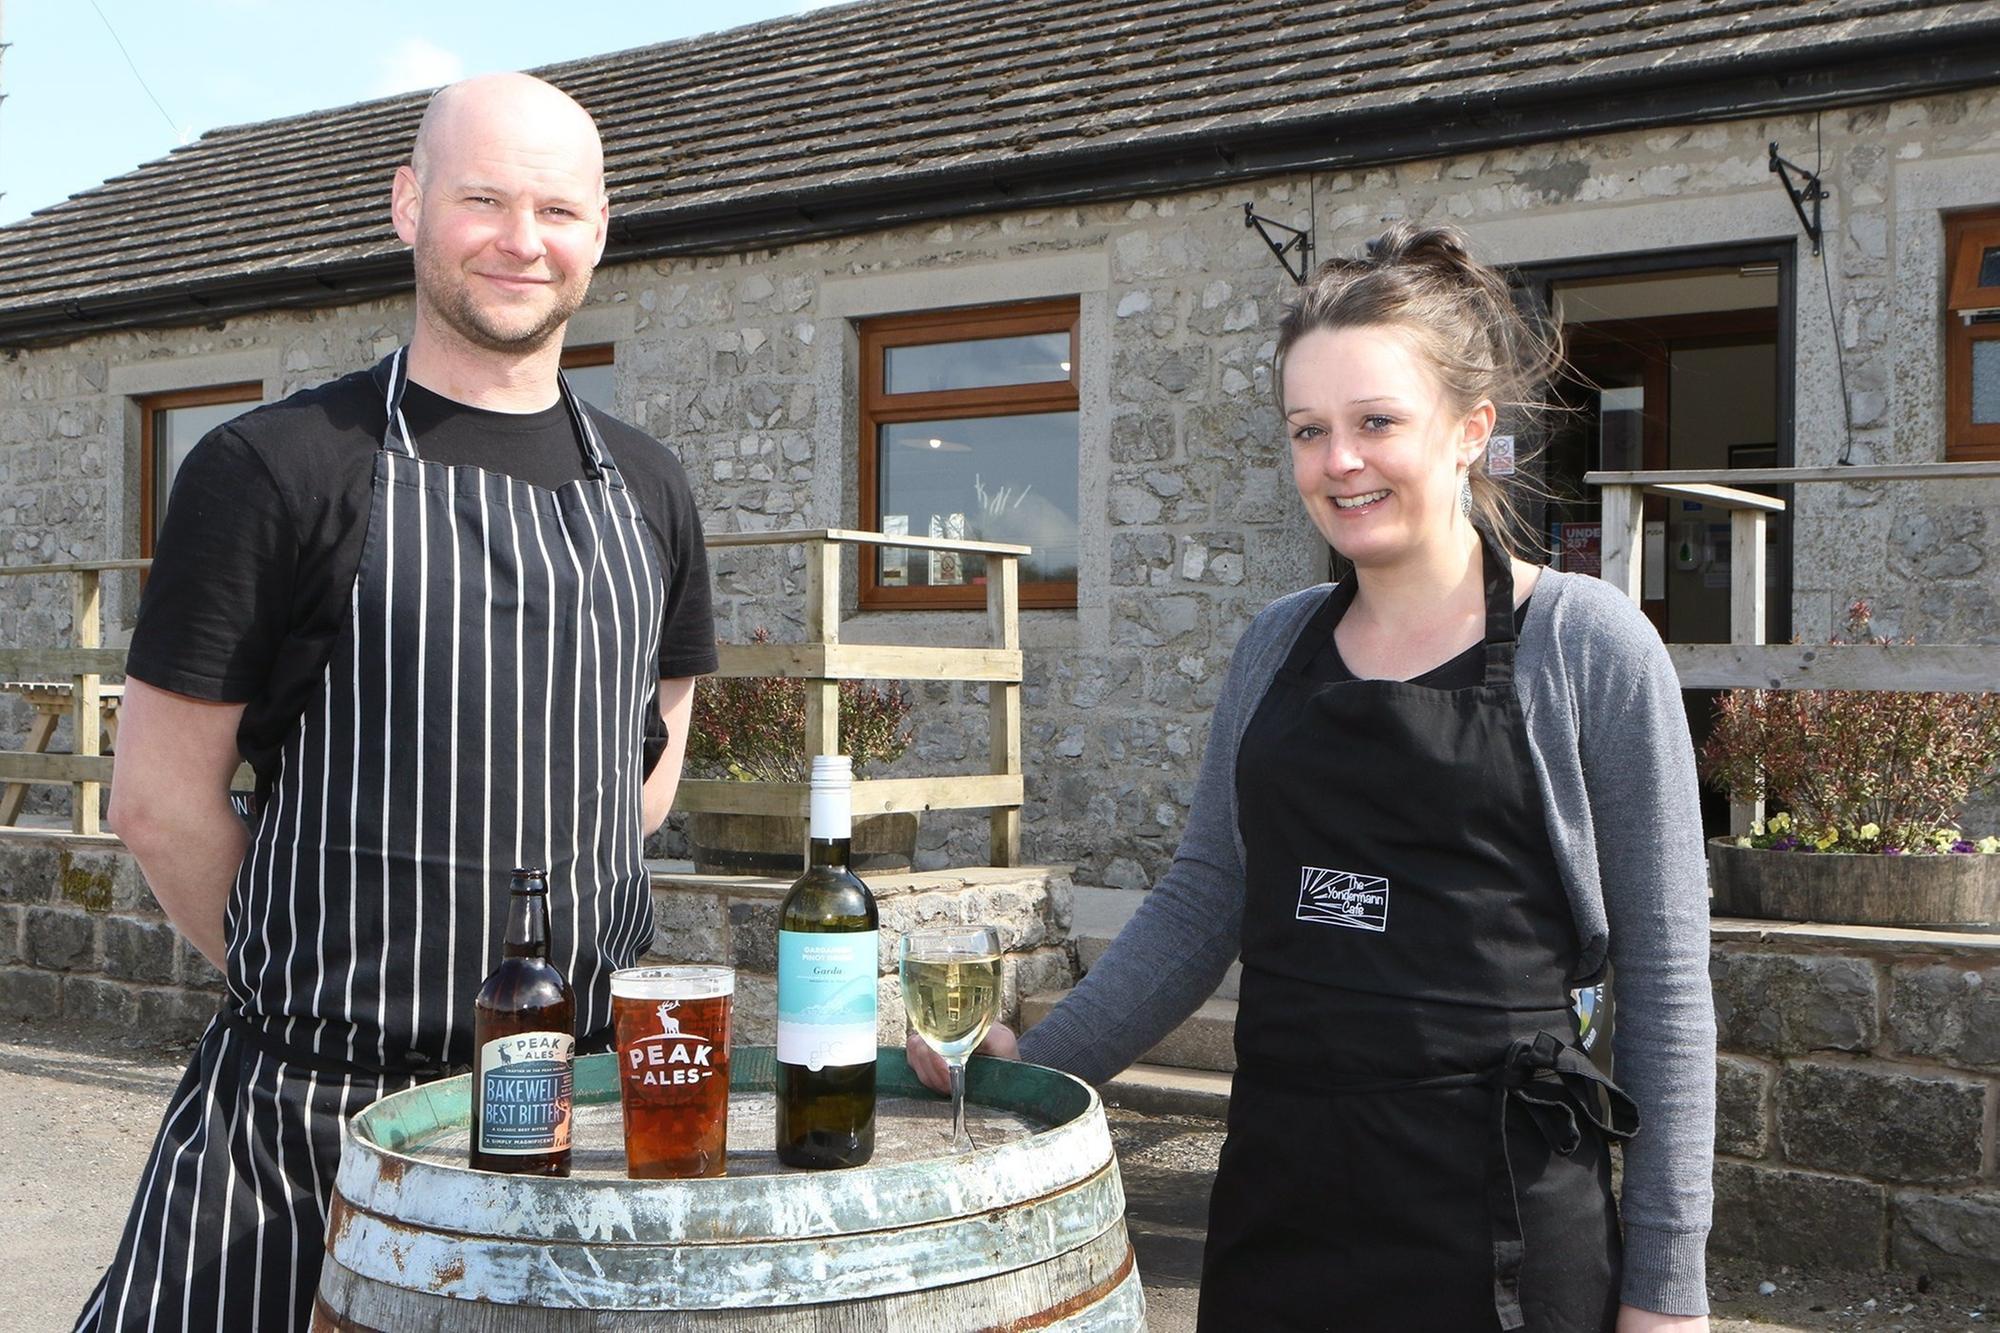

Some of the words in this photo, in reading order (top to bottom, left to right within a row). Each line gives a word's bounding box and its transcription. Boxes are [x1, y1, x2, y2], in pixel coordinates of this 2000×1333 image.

[1566, 528, 1601, 538] UNDE
[1349, 876, 1364, 890] The
[813, 966, 842, 975] Garda
[517, 1037, 561, 1051] PEAK
[629, 1043, 713, 1069] PEAK
[487, 1079, 559, 1103] BAKEWELL
[486, 1103, 516, 1125] BEST
[519, 1103, 560, 1125] BITTER
[514, 1137, 554, 1145] MAGNIFICENT
